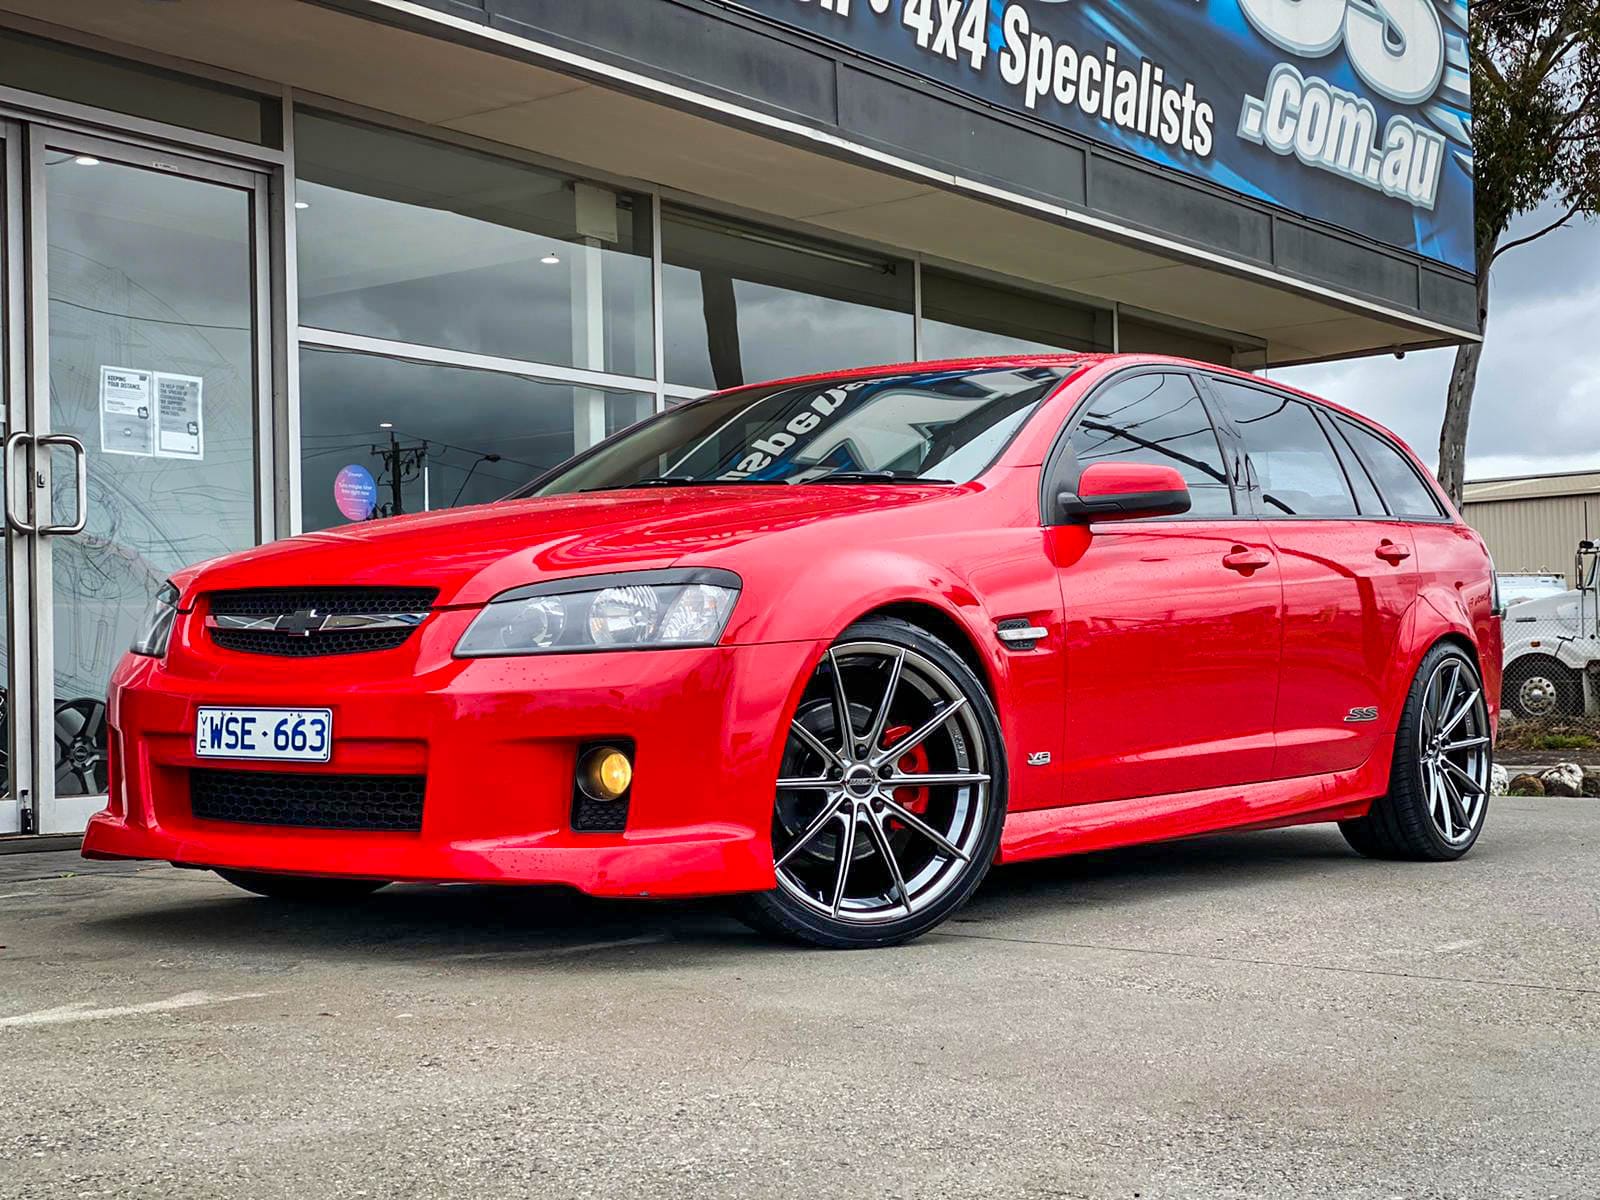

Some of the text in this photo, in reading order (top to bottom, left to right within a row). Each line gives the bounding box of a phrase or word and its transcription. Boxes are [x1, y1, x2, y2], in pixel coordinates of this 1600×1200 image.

[903, 0, 987, 70] 4x4
[1000, 5, 1213, 156] Specialists
[1242, 68, 1441, 205] .com.au
[210, 716, 326, 752] WSE 663
[1344, 706, 1378, 721] SS
